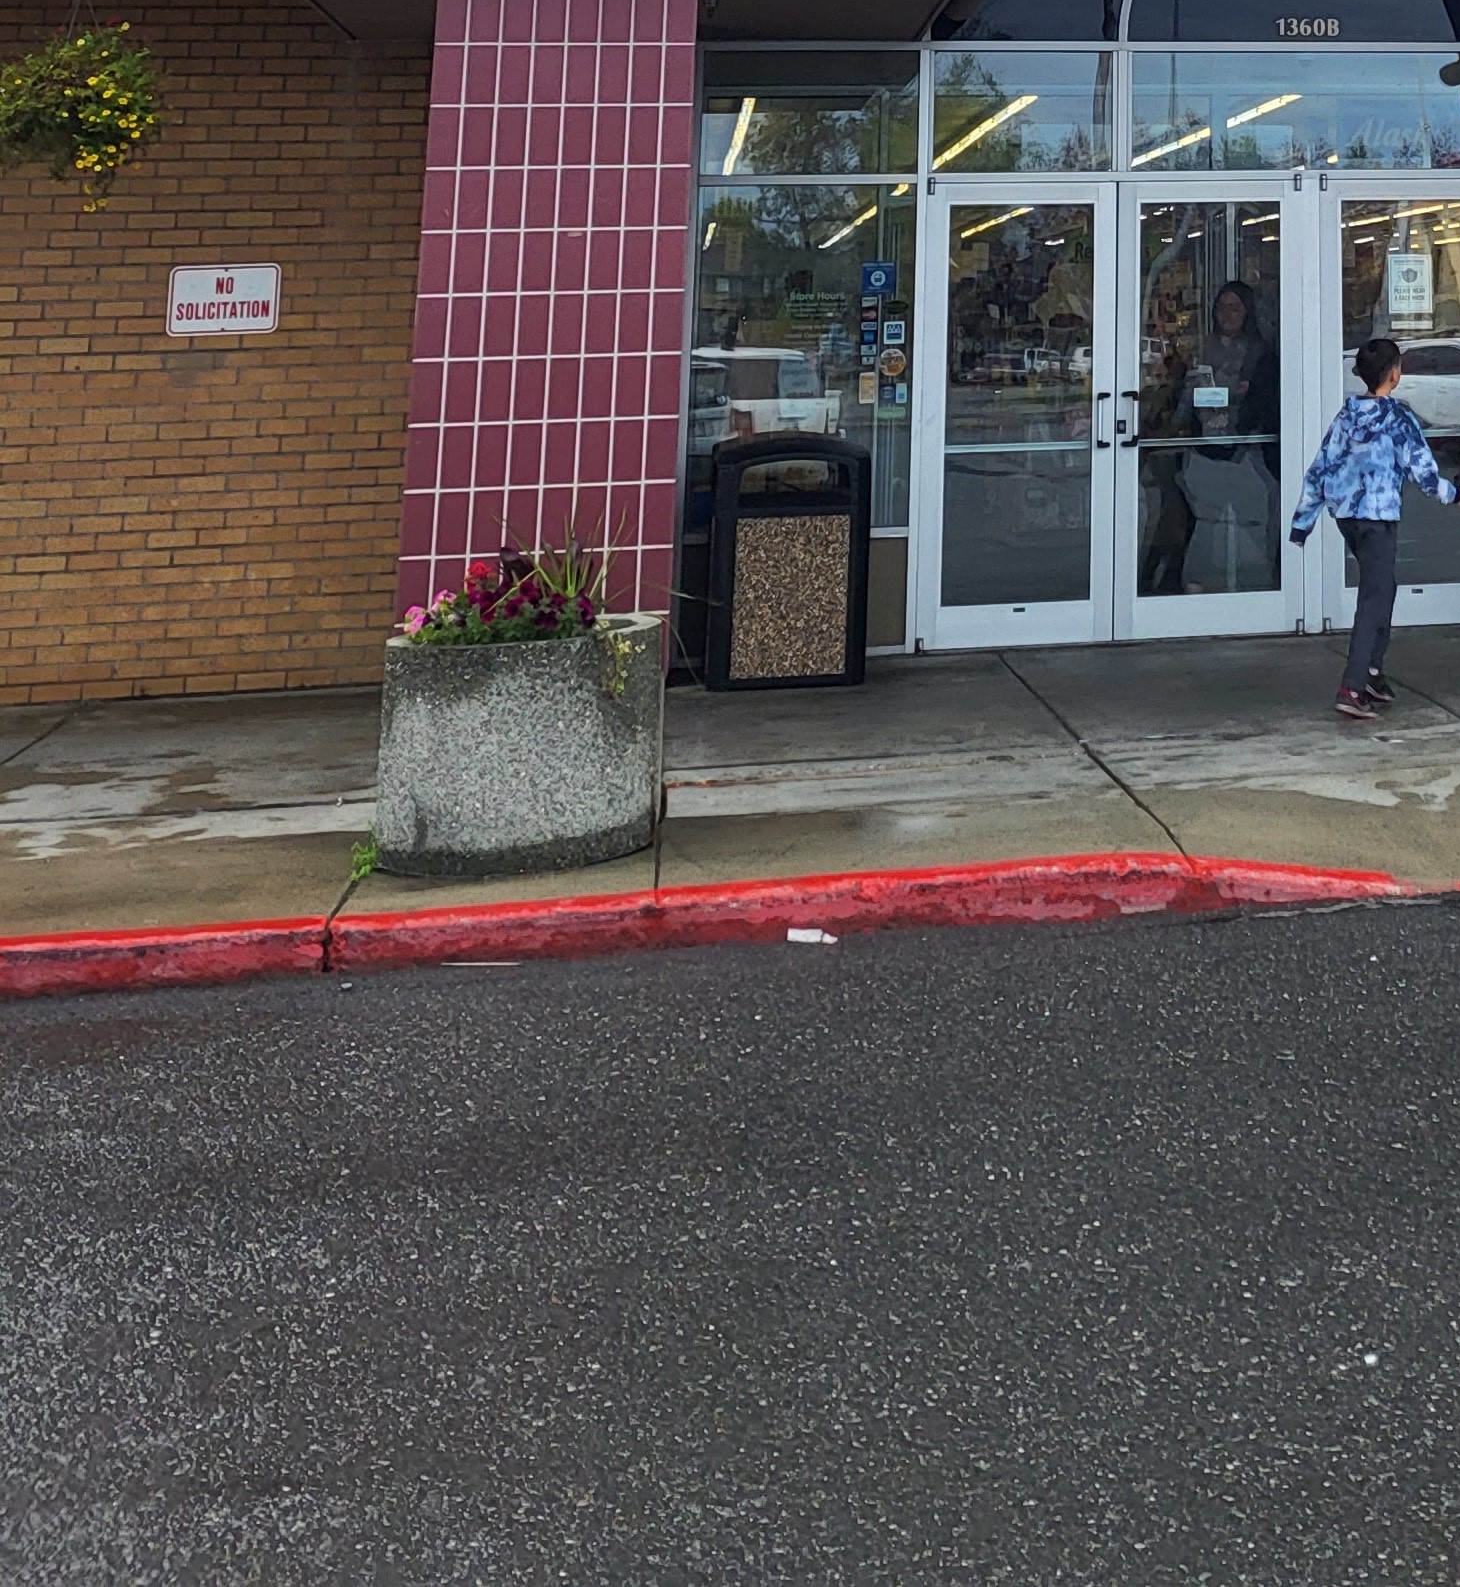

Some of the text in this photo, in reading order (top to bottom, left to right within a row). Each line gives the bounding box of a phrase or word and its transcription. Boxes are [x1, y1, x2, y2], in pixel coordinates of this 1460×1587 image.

[1275, 17, 1340, 37] 1360B
[215, 276, 234, 295] NO
[789, 292, 846, 301] Store Hours
[176, 300, 270, 321] SOLICITATION
